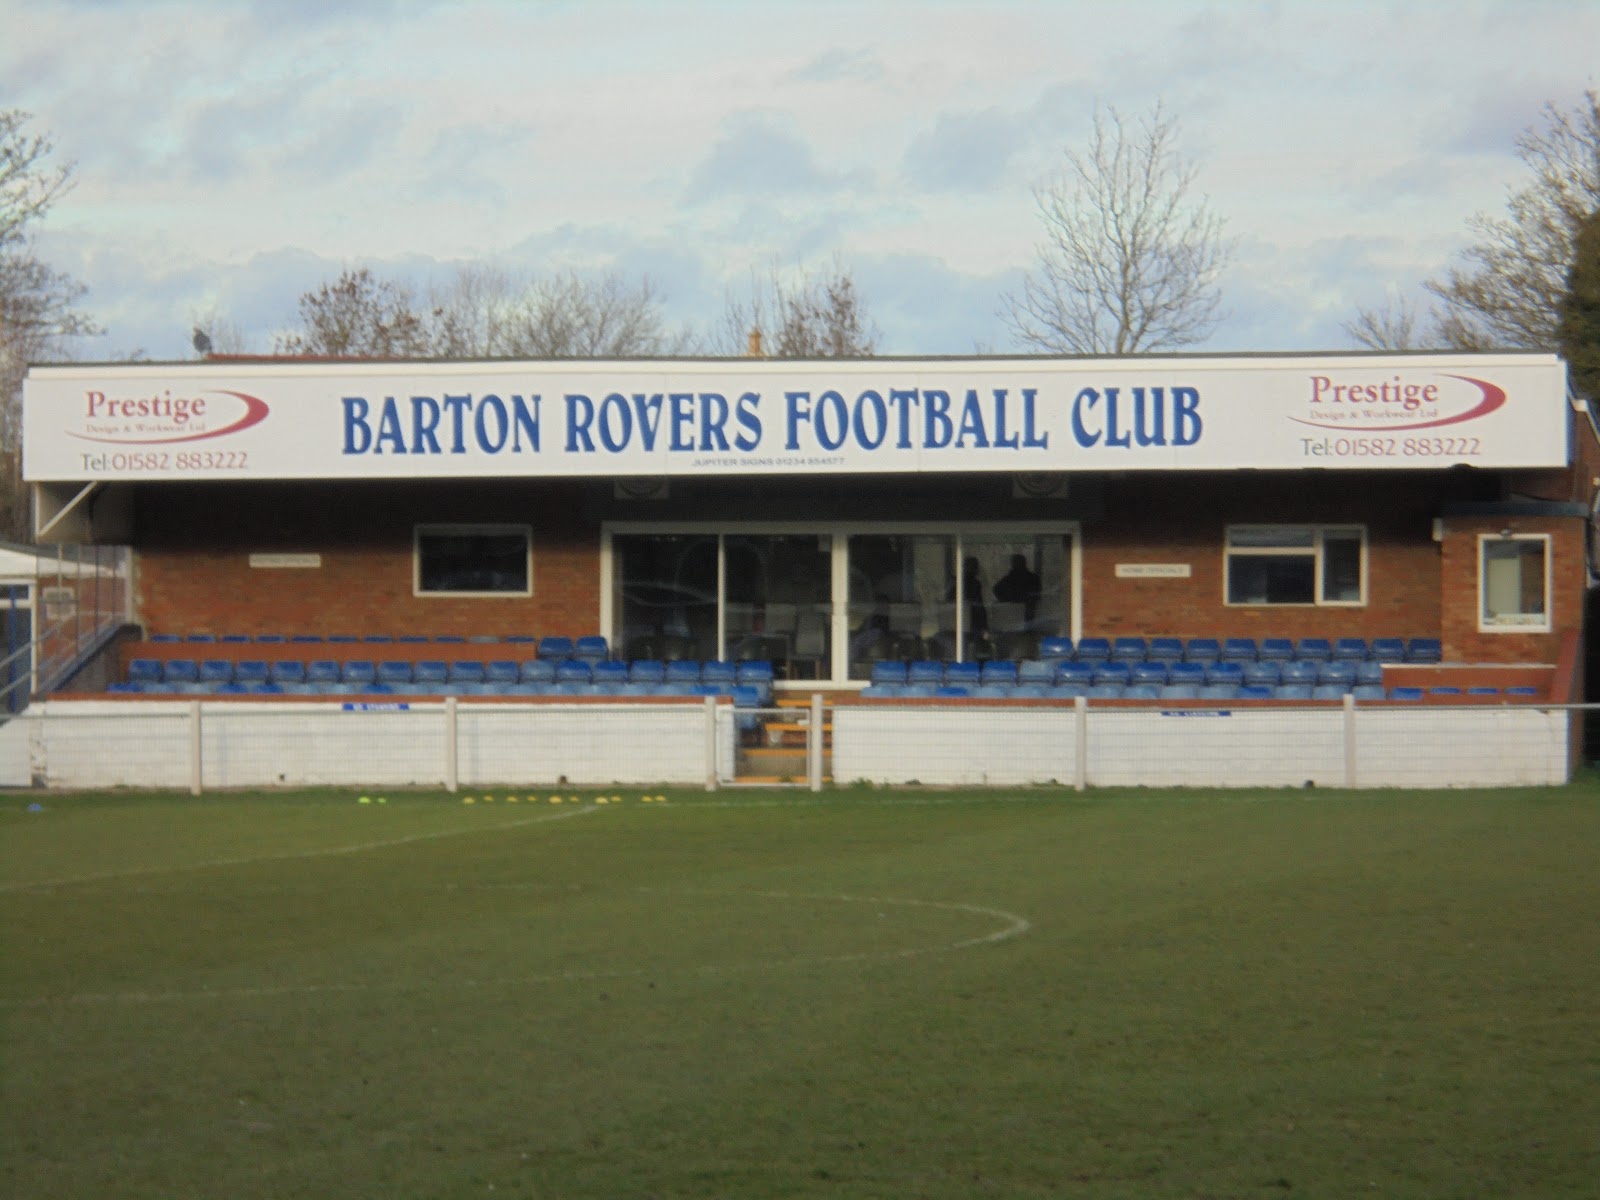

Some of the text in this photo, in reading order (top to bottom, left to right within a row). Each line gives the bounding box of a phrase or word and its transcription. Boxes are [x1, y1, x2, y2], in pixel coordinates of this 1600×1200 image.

[86, 389, 206, 425] Prestige
[1310, 376, 1439, 411] Prestige
[341, 386, 1204, 455] BARTON ROVERS FOOTBALL CLUB
[1402, 437, 1481, 456] 883222
[174, 451, 248, 471] 883222
[692, 457, 738, 467] JUPITER
[740, 457, 773, 466] SIGNS
[775, 457, 806, 466] 01234
